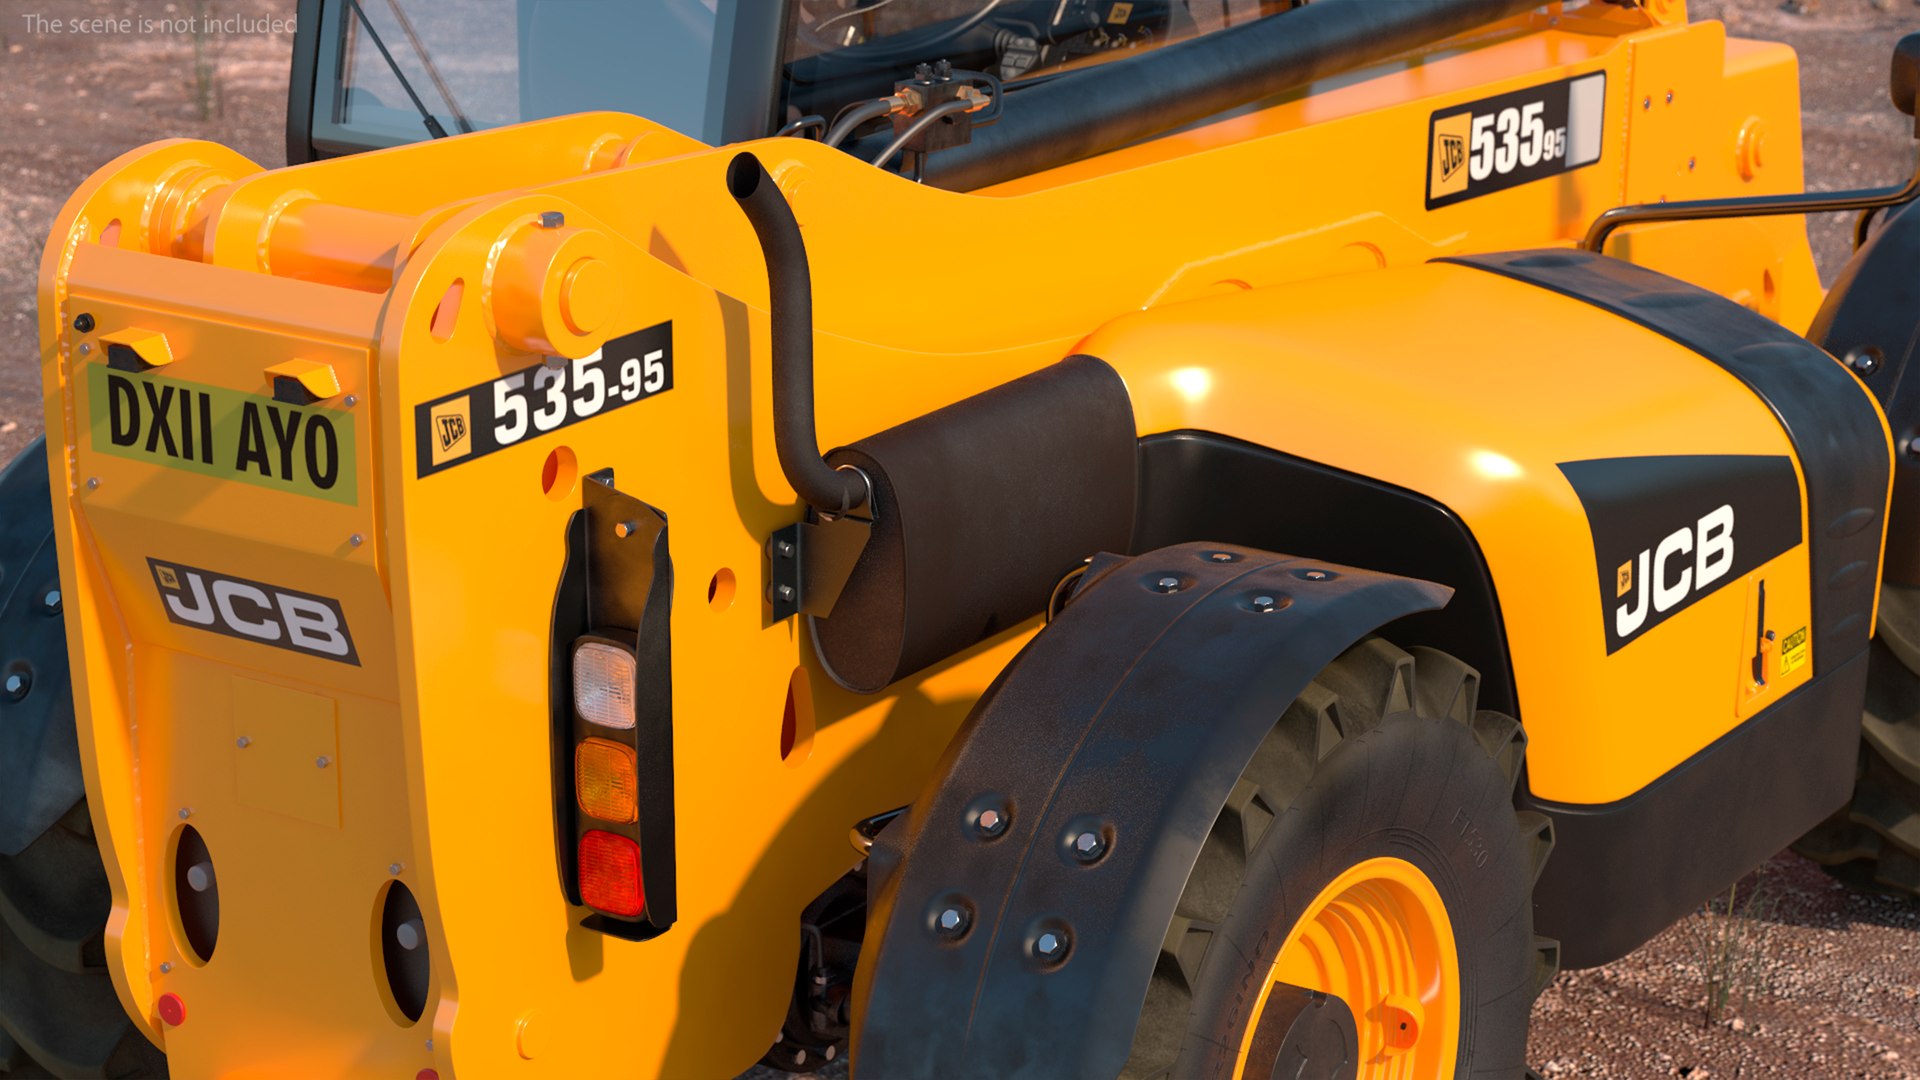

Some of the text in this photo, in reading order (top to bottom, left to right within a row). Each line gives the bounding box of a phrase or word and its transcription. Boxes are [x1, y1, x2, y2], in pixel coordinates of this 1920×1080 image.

[1442, 138, 1464, 176] JCB
[1469, 100, 1545, 181] 535
[440, 346, 665, 447] JCB 535-95
[166, 572, 349, 656] JCB
[1616, 504, 1734, 638] JCB
